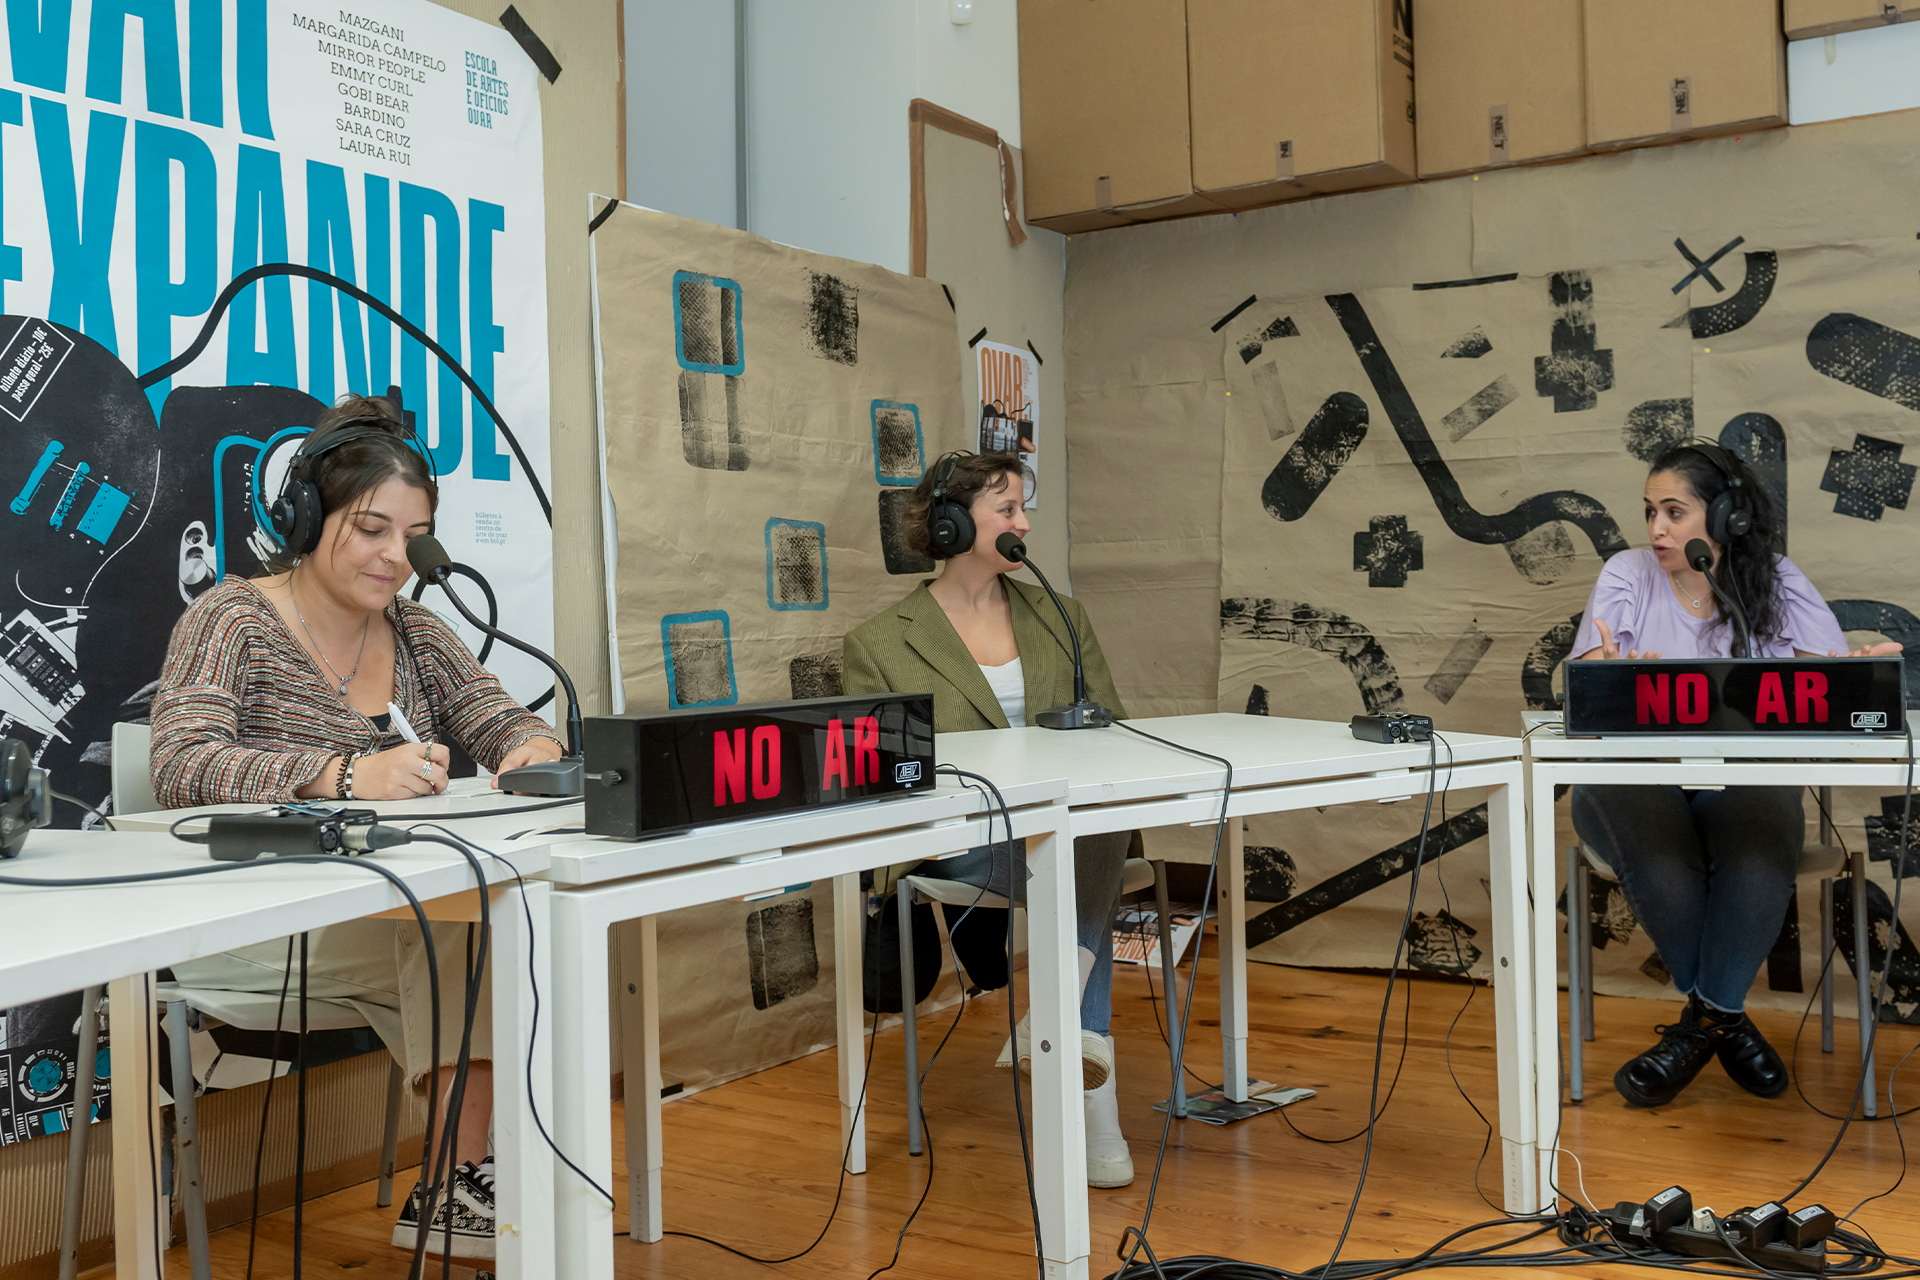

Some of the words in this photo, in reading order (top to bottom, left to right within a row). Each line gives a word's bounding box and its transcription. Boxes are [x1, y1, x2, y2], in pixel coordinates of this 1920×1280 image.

[339, 10, 404, 42] MAZGANI
[292, 13, 381, 52] MARGARIDA
[384, 42, 446, 73] CAMPELO
[318, 40, 375, 68] MIRROR
[378, 58, 426, 84] PEOPLE
[465, 50, 497, 76] ESCOLA
[331, 61, 375, 86] EMMY
[378, 76, 414, 97] CURL
[466, 69, 478, 88] DE
[481, 74, 509, 97] ARTES
[338, 83, 372, 103] GOBI
[376, 92, 410, 113] BEAR
[466, 88, 472, 105] E
[344, 101, 406, 129] BARDINO
[468, 107, 493, 129] OVAR
[336, 118, 373, 138] SARA
[375, 128, 411, 148] CRUZ
[339, 137, 386, 159] LAURA
[389, 149, 411, 166] RUI
[15, 344, 36, 369] diário
[32, 326, 48, 343] 10€
[11, 378, 31, 403] passe
[25, 359, 43, 383] geral
[38, 341, 55, 359] 25€
[1636, 672, 1709, 725] NO
[1755, 671, 1829, 724] AR
[713, 724, 781, 807] NO
[822, 715, 880, 791] AR
[0, 1068, 8, 1088] INPUT
[66, 1061, 75, 1080] SPEED
